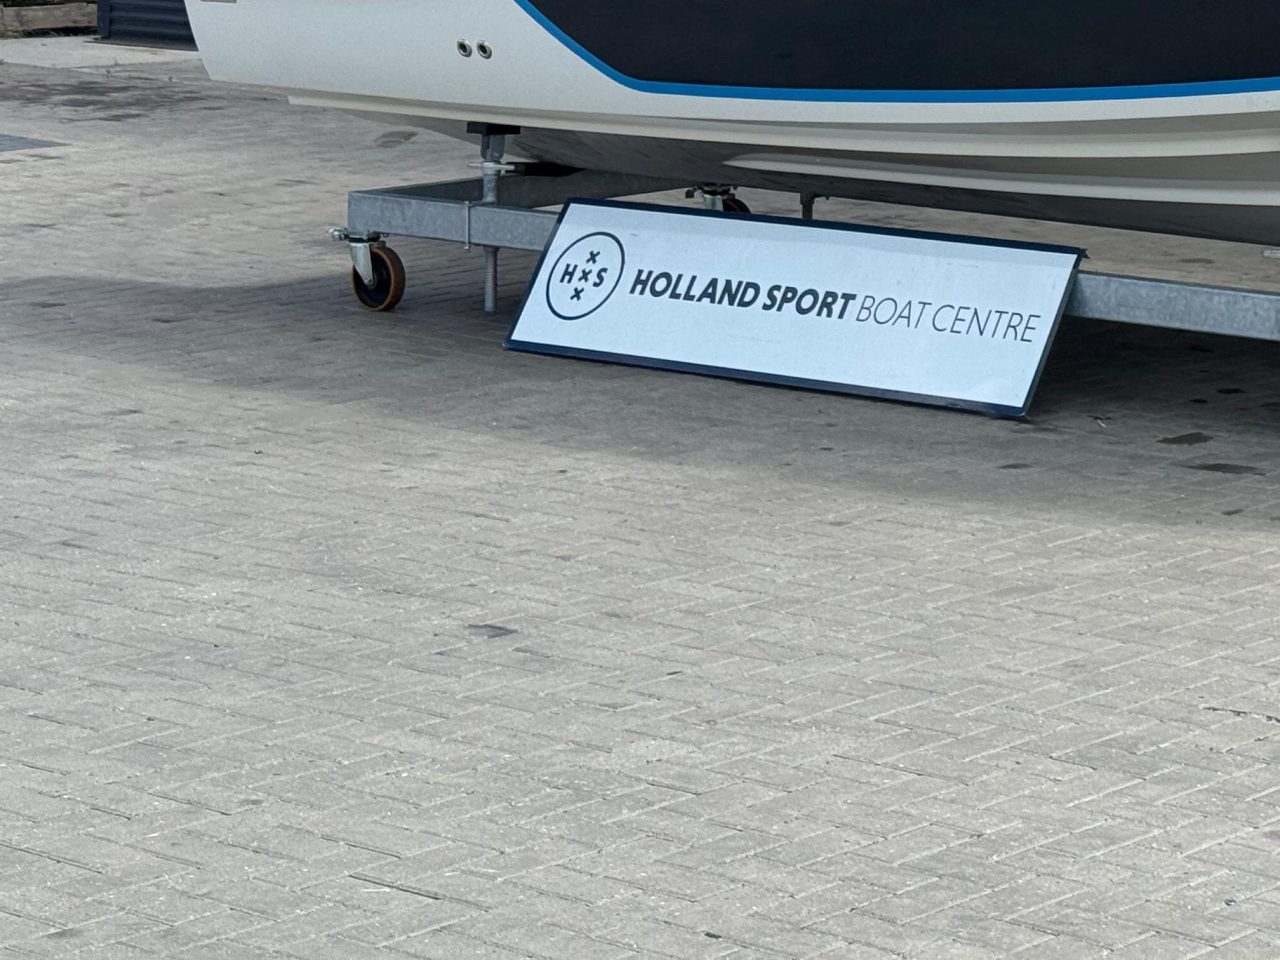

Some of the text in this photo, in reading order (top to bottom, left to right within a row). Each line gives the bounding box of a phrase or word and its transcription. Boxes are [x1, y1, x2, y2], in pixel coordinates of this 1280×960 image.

[629, 268, 1041, 343] HOLLAND SPORT BOAT CENTRE
